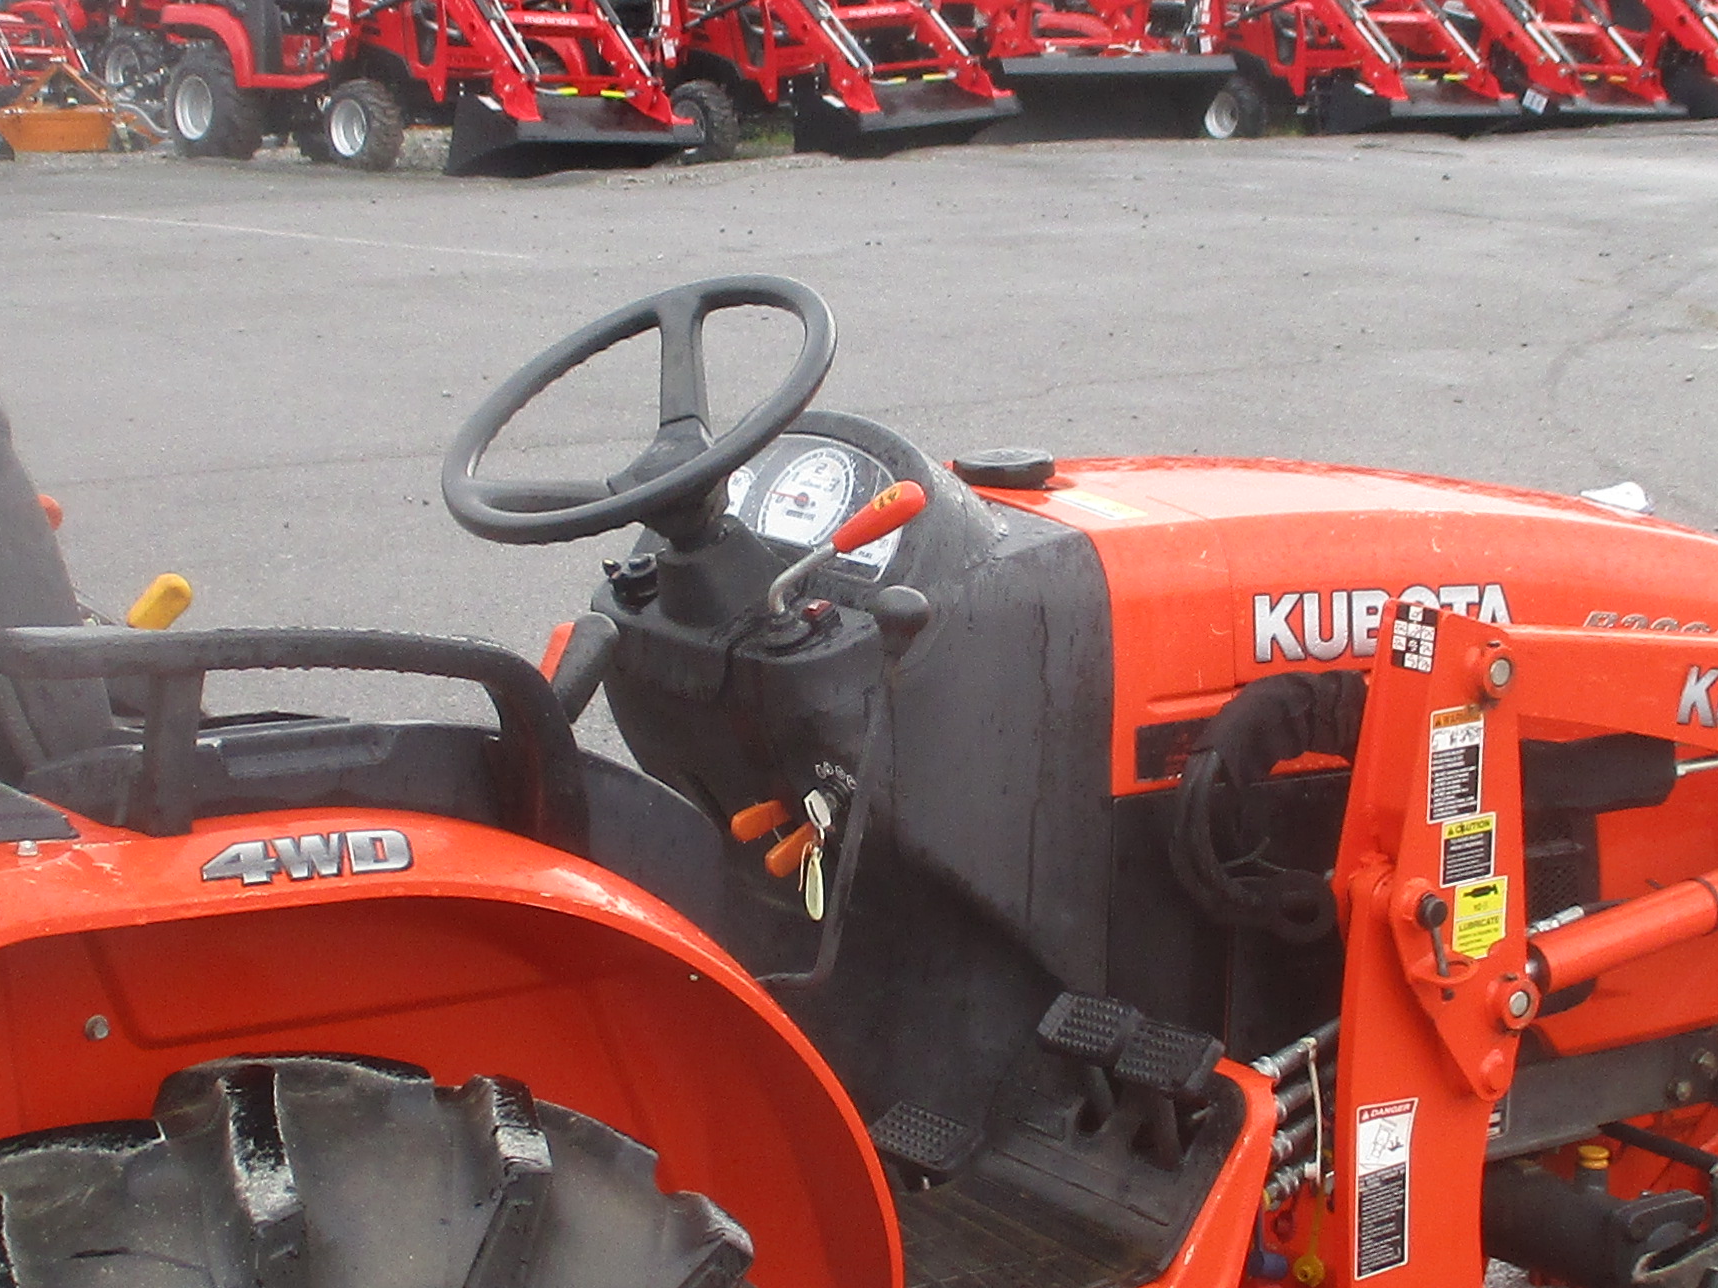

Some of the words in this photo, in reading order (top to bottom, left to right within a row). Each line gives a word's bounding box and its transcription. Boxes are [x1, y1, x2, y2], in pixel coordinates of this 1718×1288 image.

[1455, 821, 1490, 834] CAUTION
[201, 828, 414, 886] 4WD
[1458, 915, 1500, 932] LUBRICATE
[1370, 1103, 1411, 1118] DANGER
